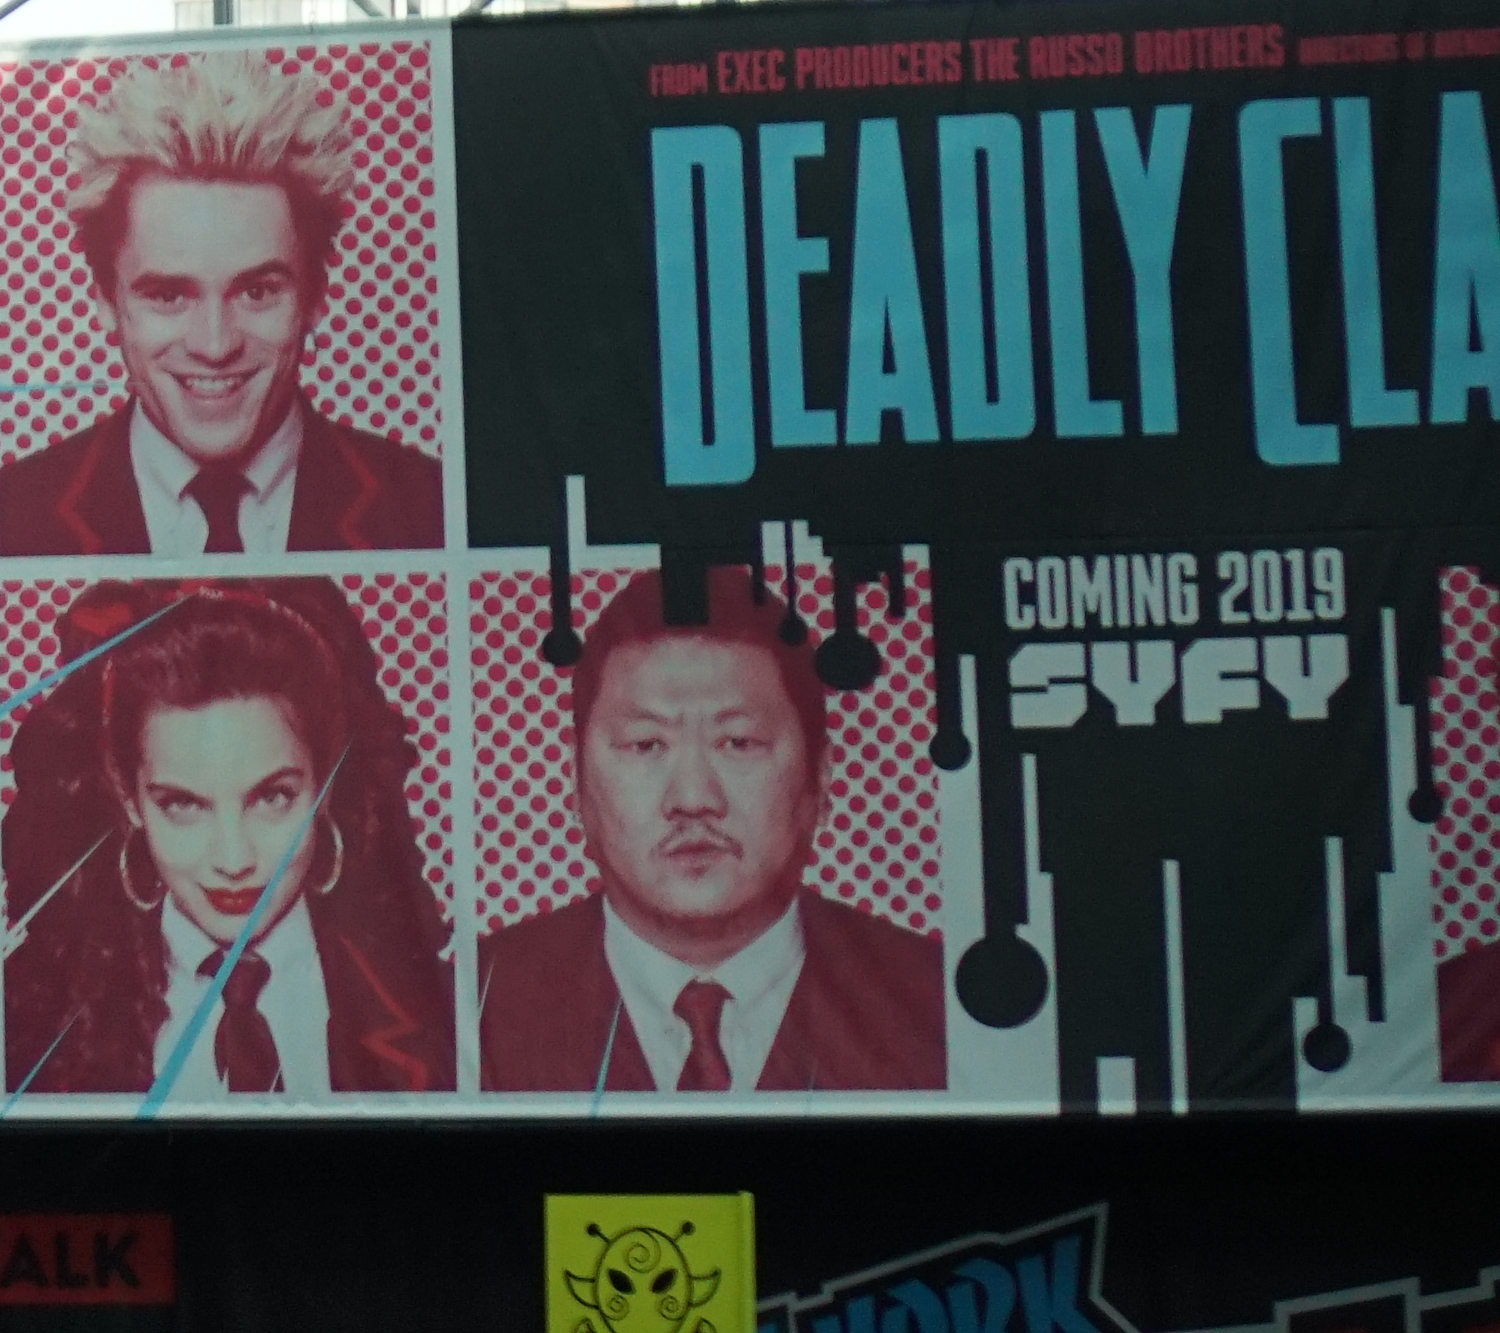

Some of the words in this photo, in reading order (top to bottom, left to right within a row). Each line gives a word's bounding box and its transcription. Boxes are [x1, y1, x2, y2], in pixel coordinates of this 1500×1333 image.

[649, 62, 708, 98] FROM
[717, 48, 786, 95] EXEC
[793, 39, 963, 91] PRODUCERS
[969, 37, 1021, 82] THE
[1029, 34, 1124, 80] RUSSO
[1134, 23, 1285, 75] BROTHERS
[650, 103, 1194, 487] DEADLY
[1237, 90, 1500, 466] CLA
[1001, 551, 1199, 631] COMING
[1215, 547, 1348, 624] 2019
[1008, 633, 1351, 729] SYFY
